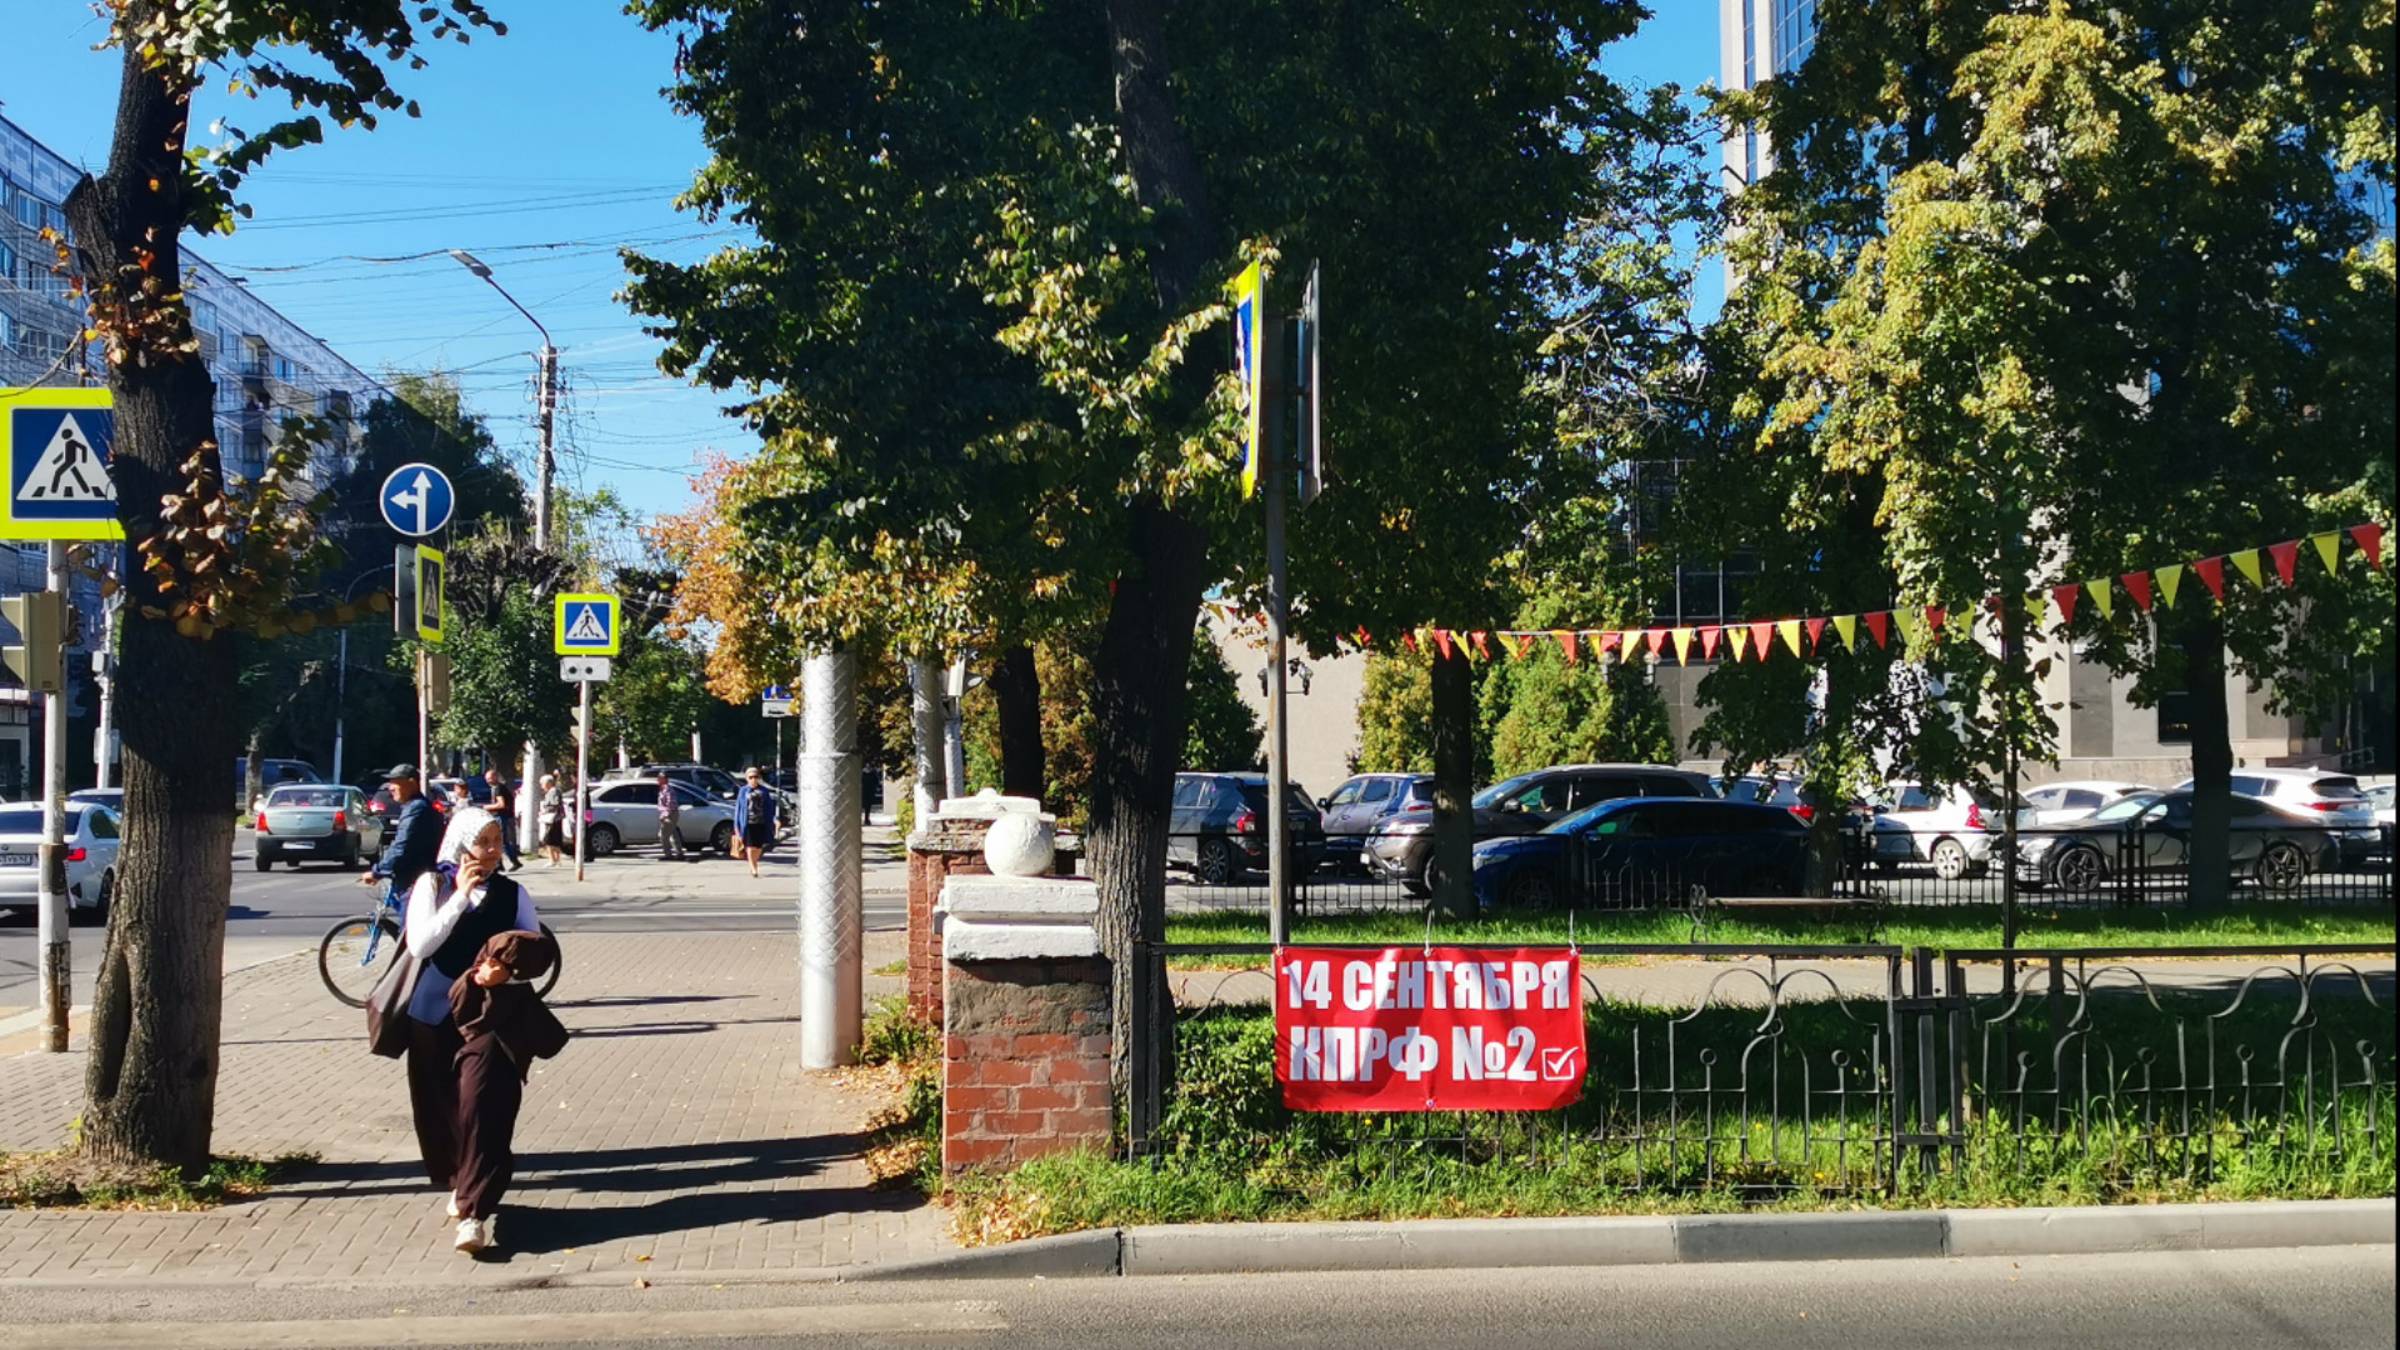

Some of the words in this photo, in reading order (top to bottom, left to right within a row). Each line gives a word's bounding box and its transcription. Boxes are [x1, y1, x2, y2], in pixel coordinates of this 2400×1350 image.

[1282, 961, 1331, 1008] 14
[1343, 961, 1569, 1010] СЕНТЯБРЯ
[1289, 1026, 1438, 1081] КПРФ
[1452, 1026, 1537, 1081] №2
